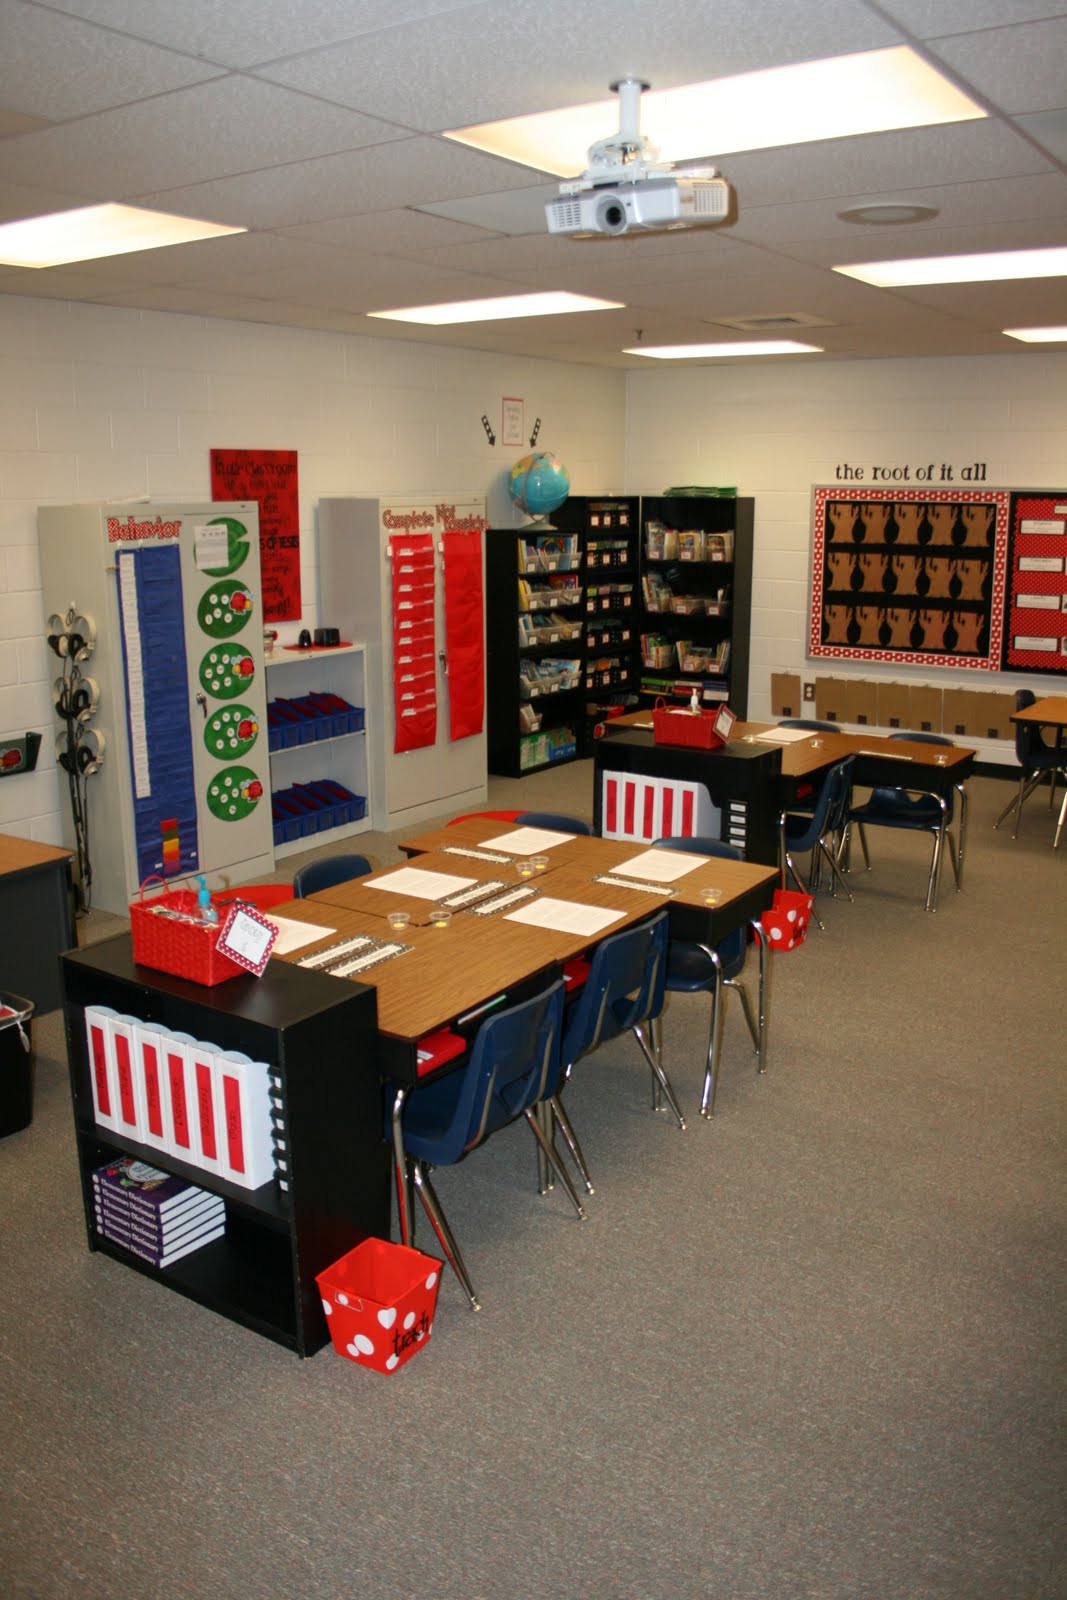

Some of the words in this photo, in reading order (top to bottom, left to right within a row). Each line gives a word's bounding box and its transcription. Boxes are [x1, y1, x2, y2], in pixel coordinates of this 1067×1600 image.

[836, 464, 864, 480] the
[872, 464, 910, 481] root
[915, 464, 934, 481] of
[940, 464, 954, 481] it
[960, 464, 986, 481] all
[106, 515, 182, 544] Behavior
[382, 509, 435, 534] Complete
[100, 1178, 128, 1197] Elementary
[128, 1191, 156, 1210] Dictionary
[102, 1188, 129, 1208] Elementary
[129, 1201, 156, 1221] Dictionary
[103, 1198, 131, 1218] Elementary
[131, 1212, 158, 1231] Dictionary
[103, 1209, 130, 1229] Elementary
[131, 1222, 158, 1242] Dictionary
[104, 1219, 131, 1239] Elementary
[132, 1233, 159, 1253] Dictionary
[104, 1230, 131, 1250] Elementary
[130, 1245, 156, 1266] Dictionary
